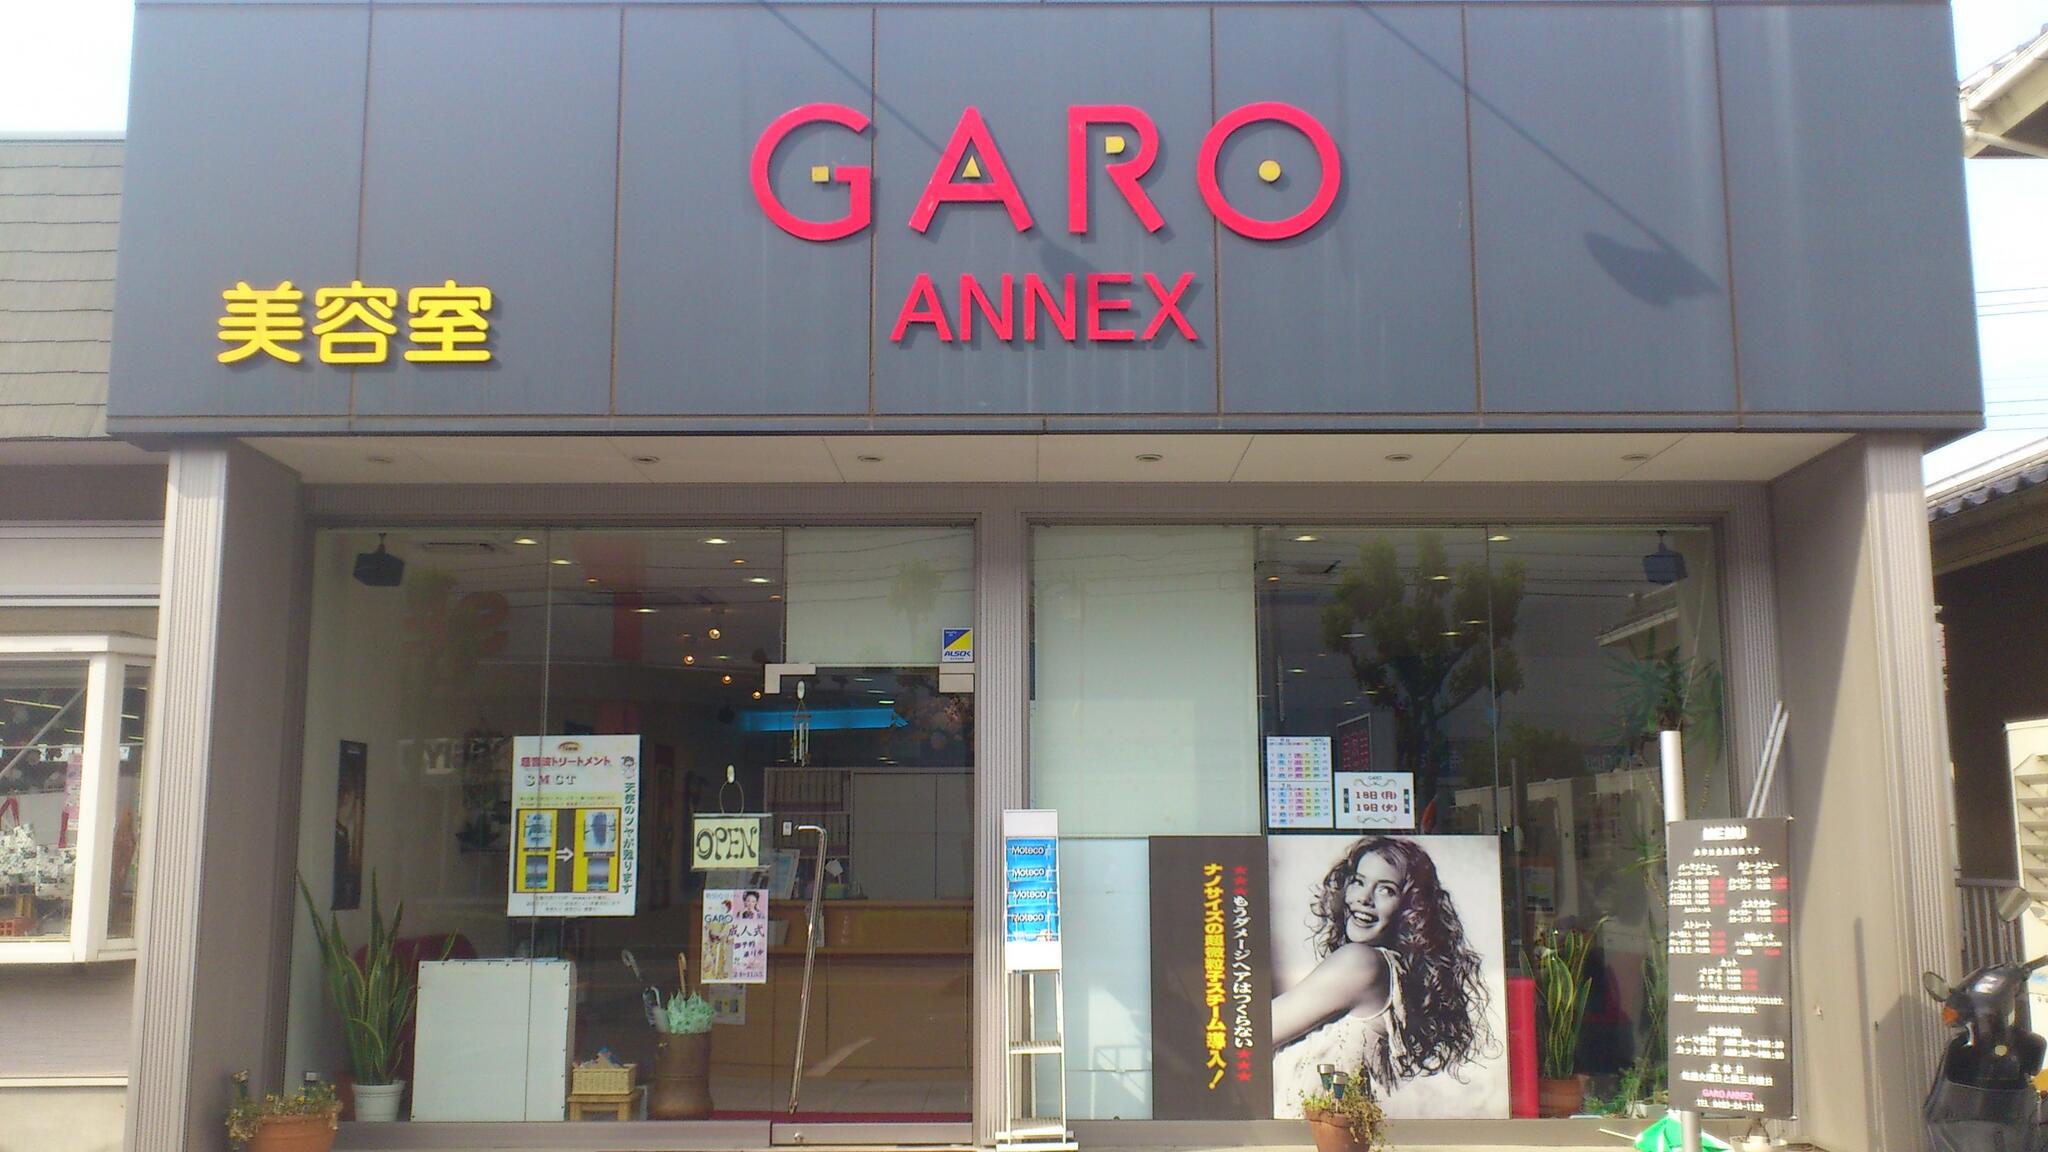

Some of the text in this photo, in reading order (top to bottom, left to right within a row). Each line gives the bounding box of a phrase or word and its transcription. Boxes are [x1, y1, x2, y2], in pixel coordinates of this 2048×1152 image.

[750, 102, 1341, 241] GARO
[891, 273, 1197, 342] ANNEX
[219, 281, 492, 363] 美容室
[695, 826, 758, 860] OPEN
[1011, 846, 1044, 855] Moteco
[1012, 867, 1045, 878] Moteco
[1013, 889, 1047, 899] Moteco
[704, 914, 734, 924] GARO
[1012, 912, 1045, 923] Moteco
[728, 925, 765, 937] 成人式
[1232, 895, 1254, 1048] もうダメージヘアはつくらない
